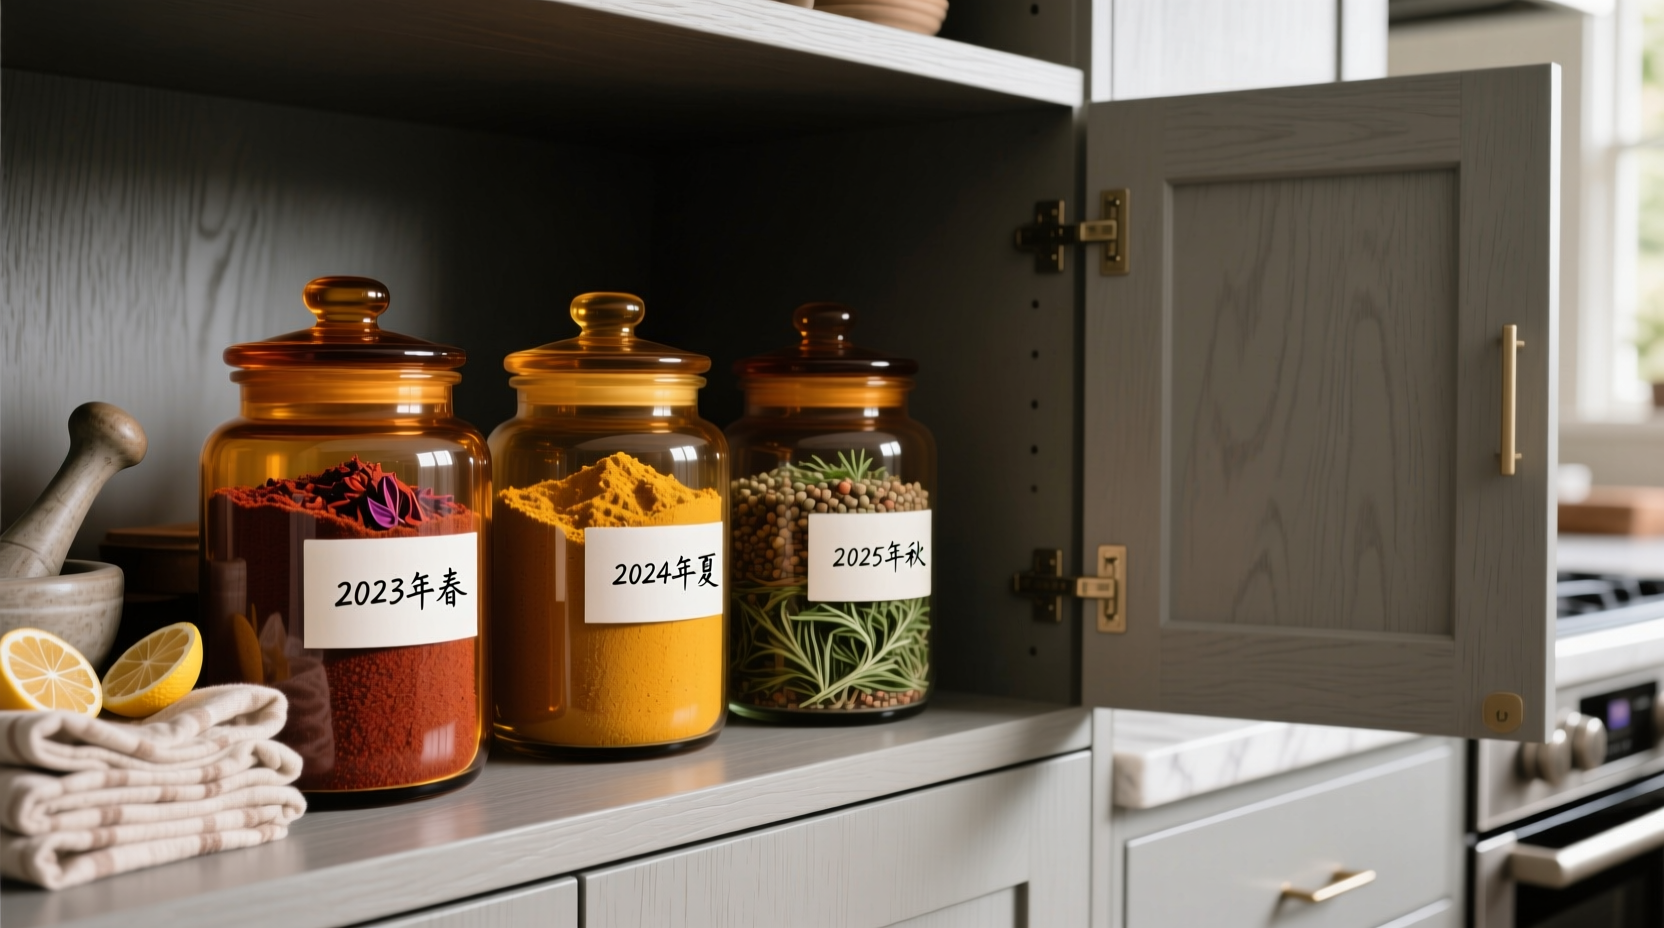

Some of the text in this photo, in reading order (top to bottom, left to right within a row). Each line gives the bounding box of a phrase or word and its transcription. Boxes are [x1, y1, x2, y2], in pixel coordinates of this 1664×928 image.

[611, 552, 720, 591] 2024年夏
[832, 540, 927, 573] 2025年秋
[334, 566, 468, 611] 2023年春
